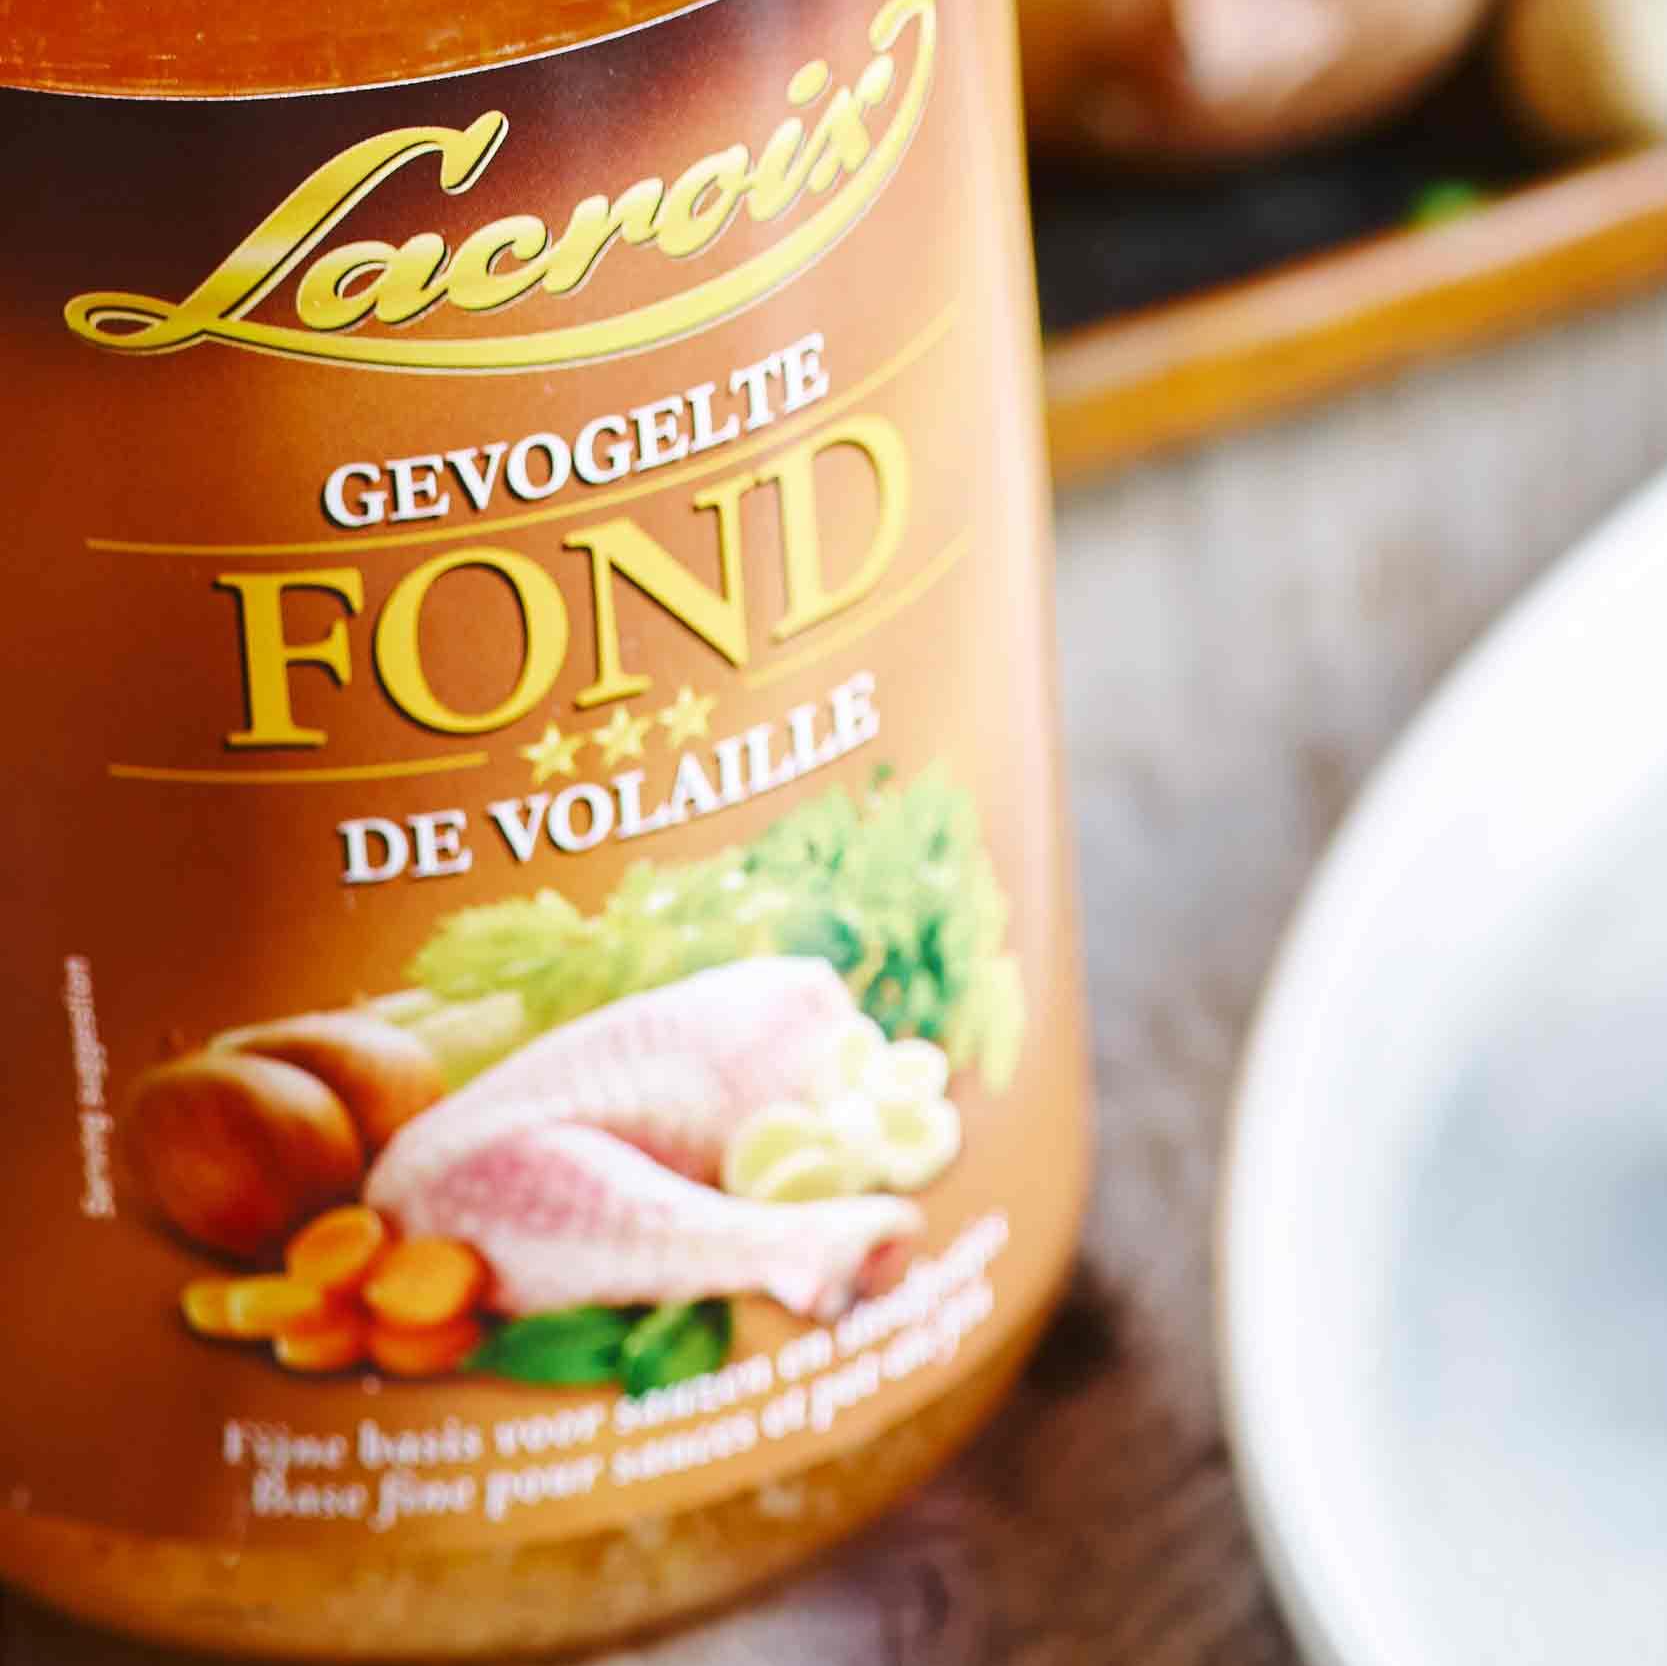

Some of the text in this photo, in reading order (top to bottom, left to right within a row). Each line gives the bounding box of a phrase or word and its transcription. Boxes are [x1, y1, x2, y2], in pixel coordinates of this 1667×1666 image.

[322, 332, 830, 528] GEVOGELTE
[213, 411, 912, 753] FOND
[339, 670, 880, 886] DE VOLAILLE
